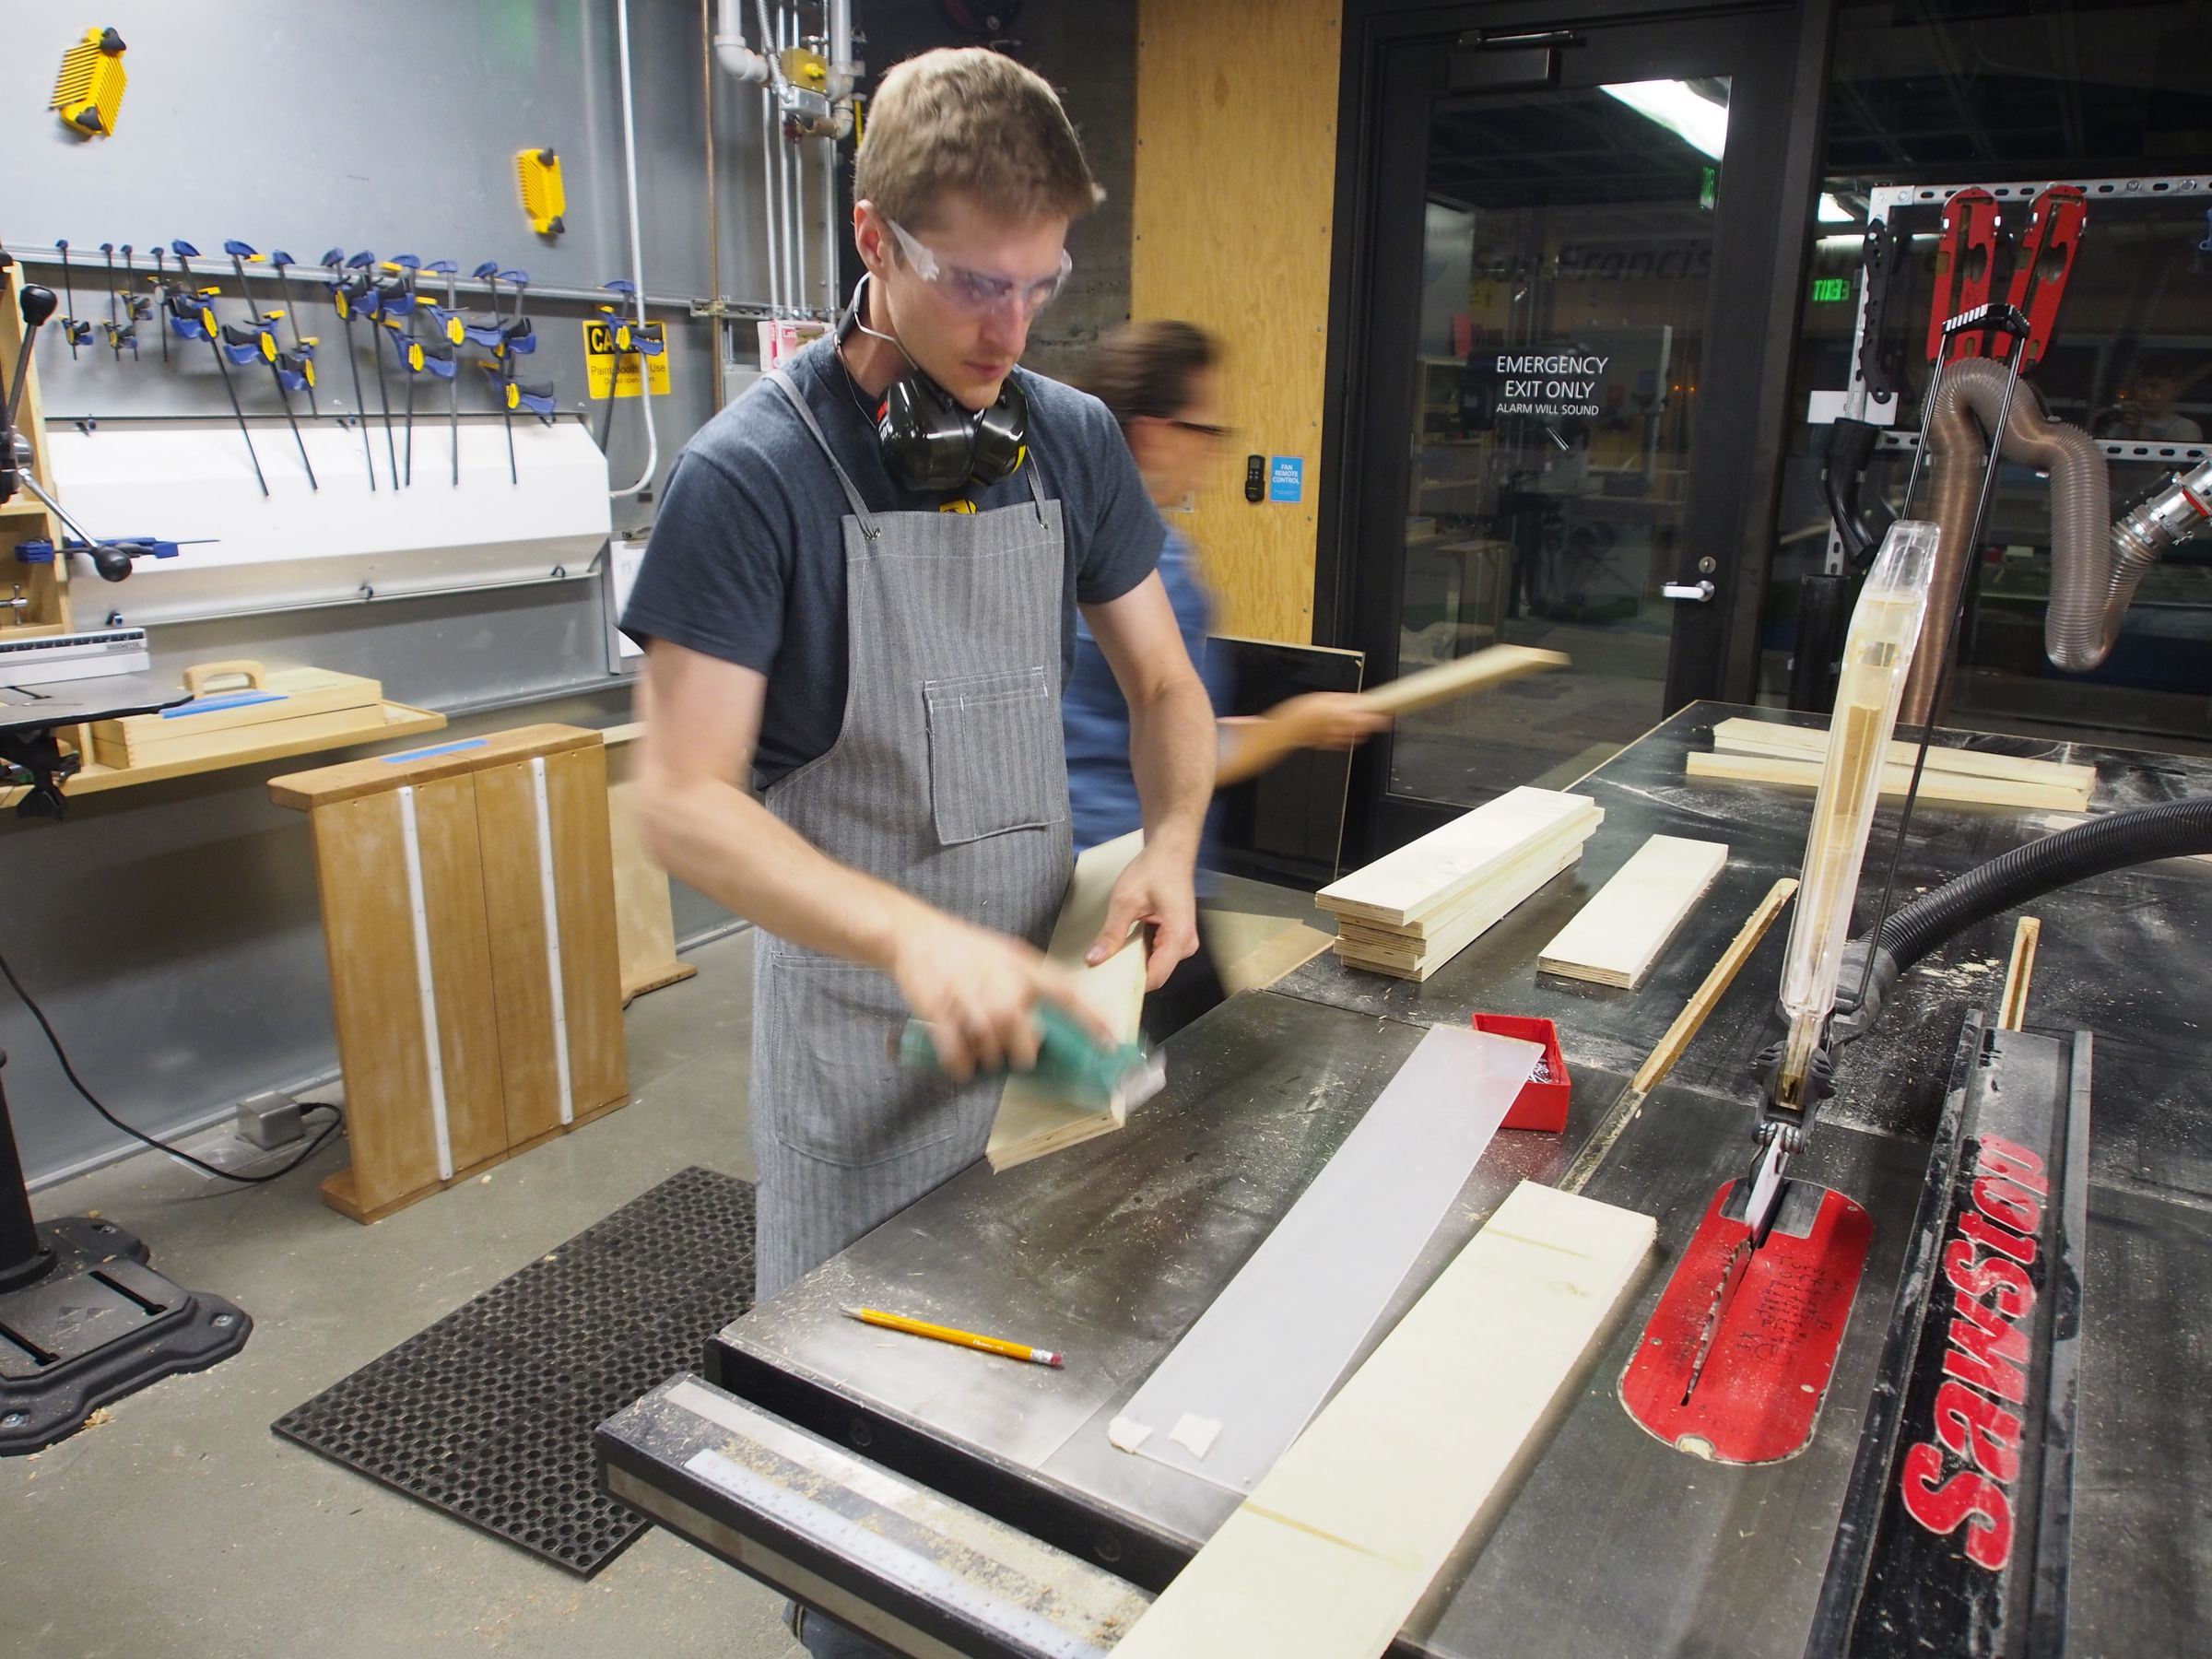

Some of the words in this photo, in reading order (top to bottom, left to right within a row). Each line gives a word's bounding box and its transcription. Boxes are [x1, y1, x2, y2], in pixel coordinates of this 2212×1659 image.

[616, 365, 639, 374] ooth
[649, 363, 665, 373] Use
[1497, 356, 1608, 374] EMERGENCY
[1504, 380, 1543, 397] EXIT
[1546, 380, 1595, 398] ONLY
[1496, 403, 1533, 414] ALARM
[1535, 404, 1559, 415] WILL
[1561, 404, 1599, 416] SOUND
[1275, 469, 1299, 477] REMOTE
[1272, 476, 1300, 485] CONTROL
